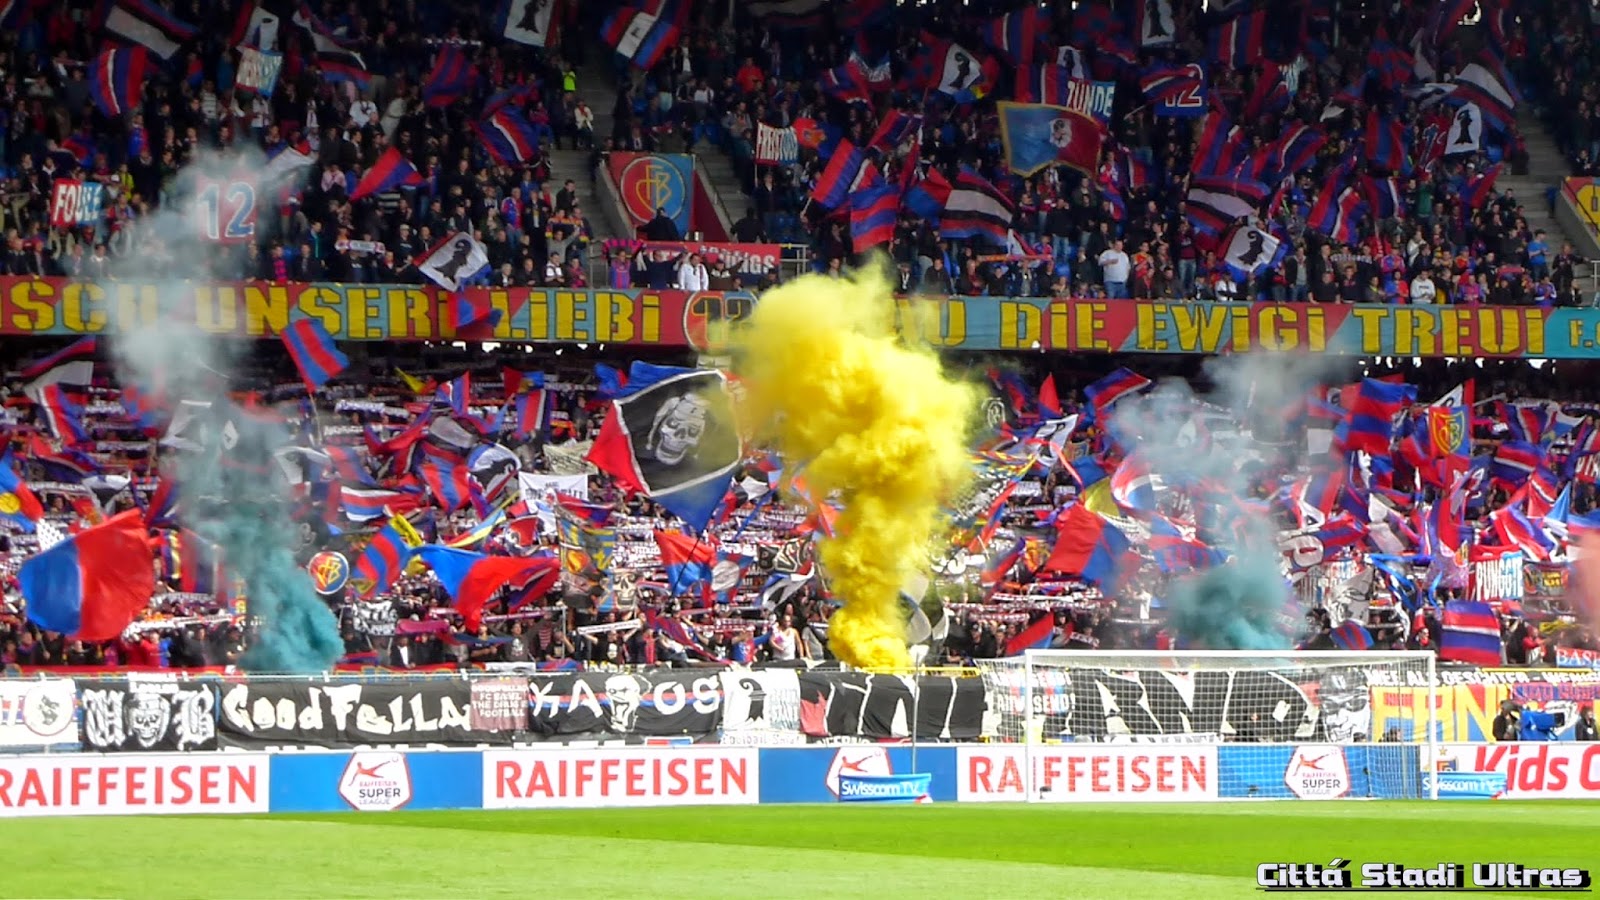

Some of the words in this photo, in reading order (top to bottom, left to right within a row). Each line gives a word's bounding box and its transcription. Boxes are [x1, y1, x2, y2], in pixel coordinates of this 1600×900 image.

[203, 181, 257, 239] 12
[497, 757, 747, 799] RAIFFEISEN
[969, 755, 1207, 793] RAFFEISEN
[1475, 743, 1570, 792] Kids
[359, 788, 401, 798] SUPER
[841, 782, 899, 796] Swisscom
[1302, 779, 1341, 788] SUPER
[1423, 776, 1480, 792] Sisscom
